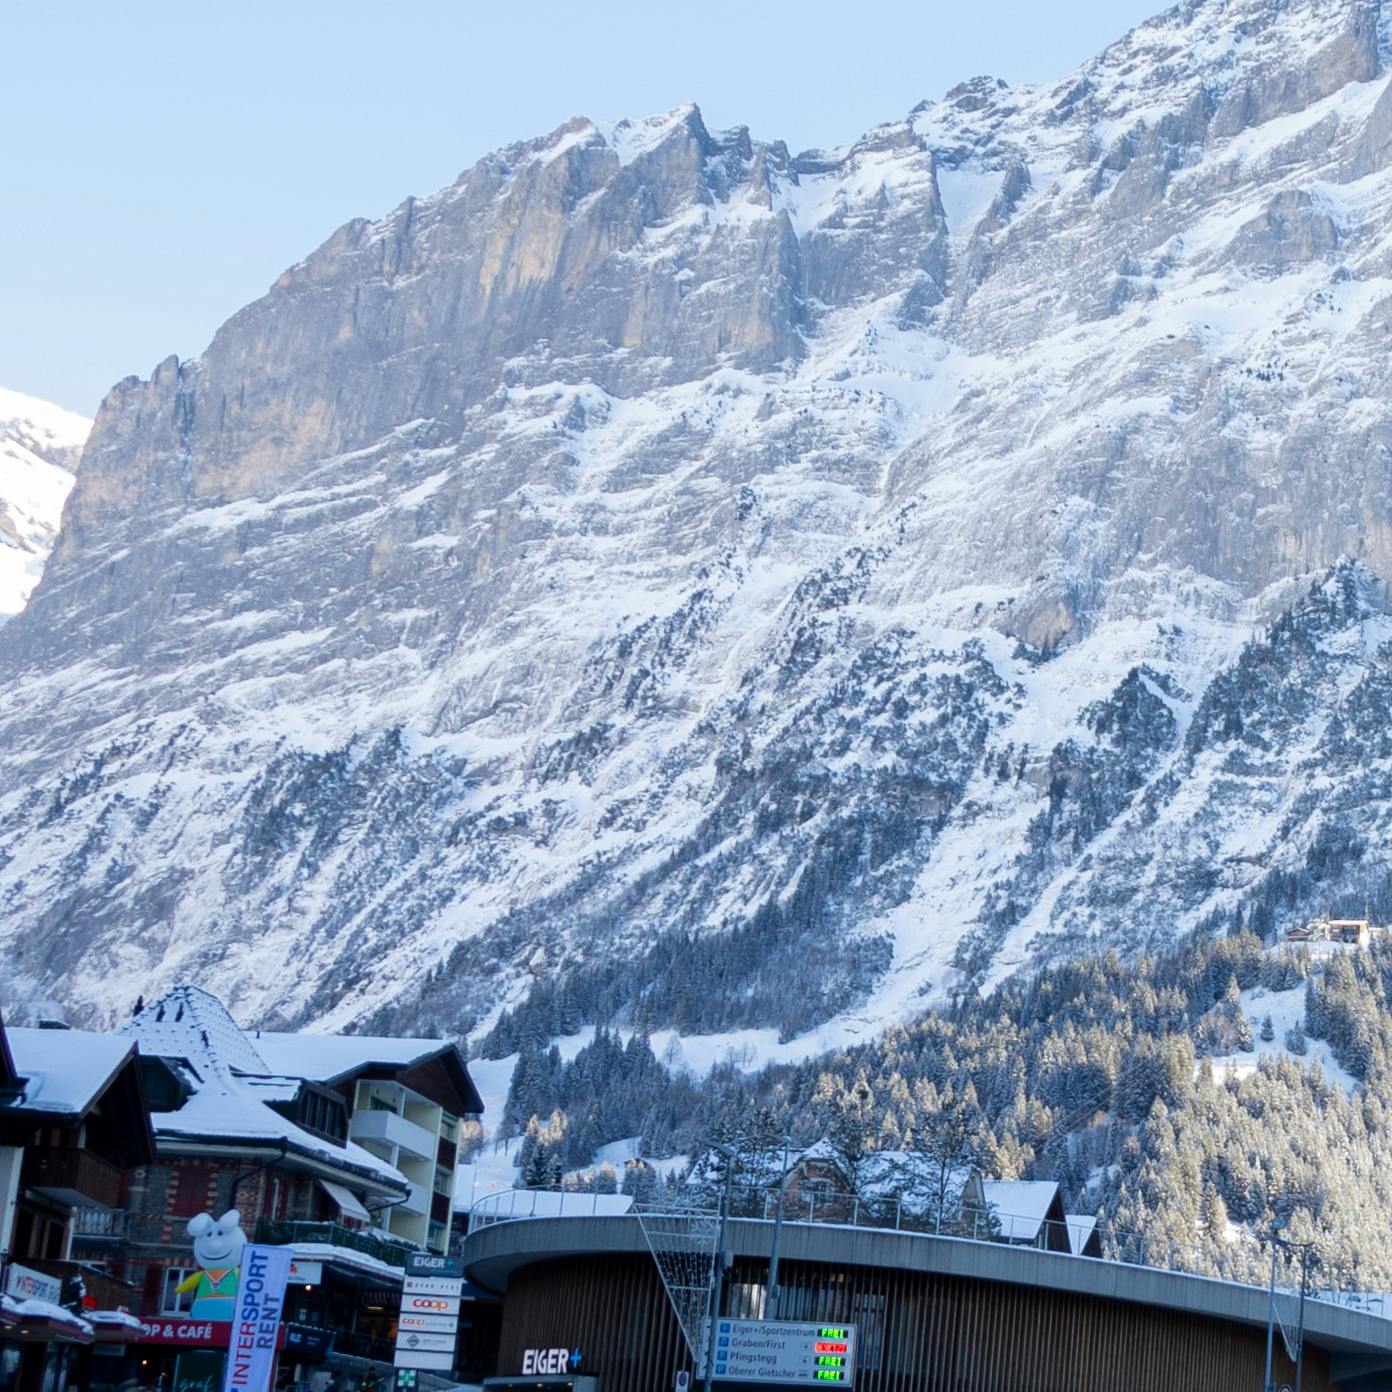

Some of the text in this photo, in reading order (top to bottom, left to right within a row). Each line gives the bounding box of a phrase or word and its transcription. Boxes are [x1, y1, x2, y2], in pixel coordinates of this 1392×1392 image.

[412, 1298, 448, 1311] coop
[232, 1250, 268, 1385] INTERSPORT
[257, 1293, 280, 1349] RENT
[162, 1324, 174, 1337] &
[177, 1322, 213, 1340] CAFÉ
[732, 1325, 815, 1337] Eiger+/Sportzentrum
[821, 1328, 845, 1339] FREI
[732, 1338, 785, 1349] Graben/First
[522, 1347, 582, 1375] EIGER+
[730, 1352, 777, 1364] Pfingstegg
[818, 1356, 842, 1367] FREI
[728, 1366, 756, 1376] Oberer
[758, 1367, 796, 1378] Gletscher
[817, 1371, 841, 1381] FREI
